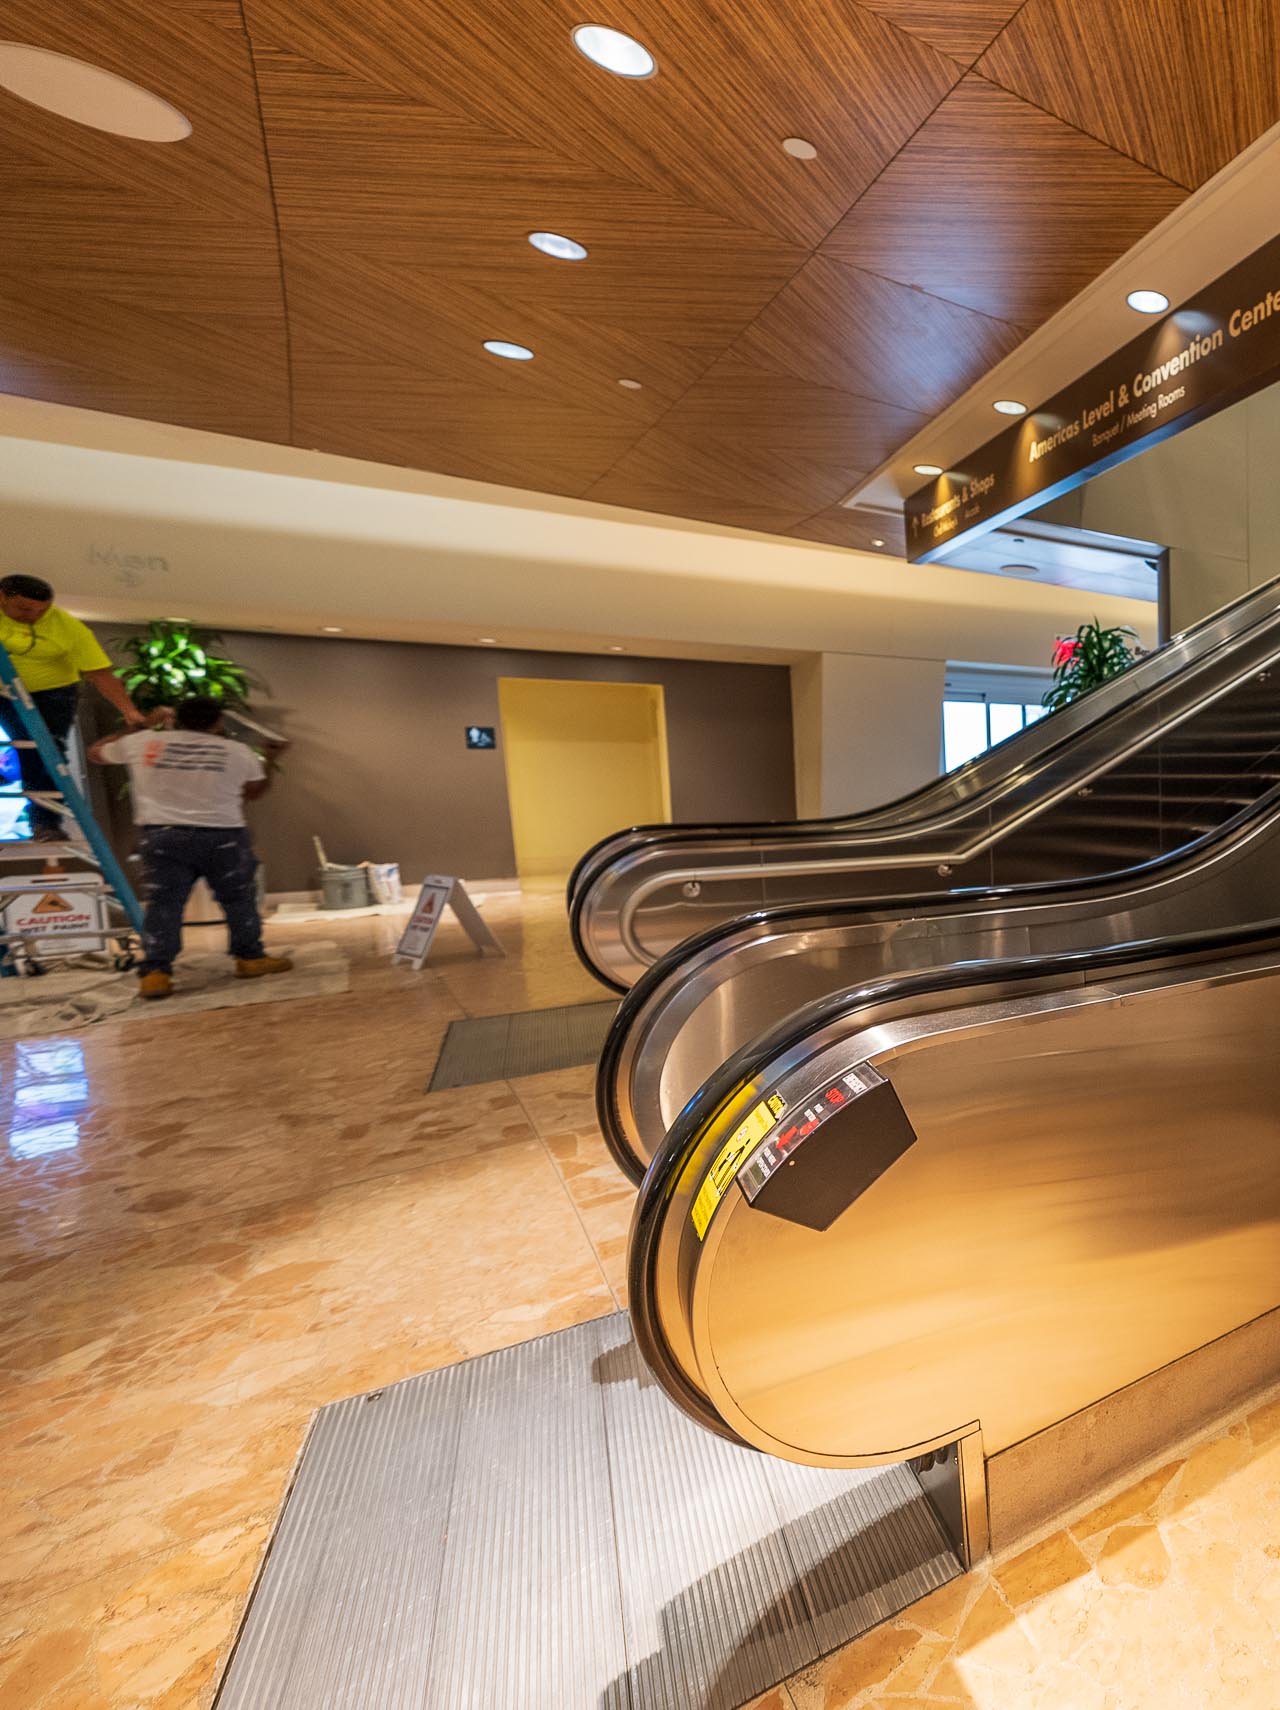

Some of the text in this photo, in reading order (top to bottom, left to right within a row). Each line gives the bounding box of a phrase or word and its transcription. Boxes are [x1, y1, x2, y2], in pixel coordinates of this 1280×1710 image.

[1029, 420, 1080, 463] Americas
[1082, 389, 1114, 430] Level
[1118, 384, 1130, 408] &
[1133, 329, 1223, 398] Convention
[1126, 403, 1157, 428] Meeting
[1158, 386, 1185, 410] Rooms
[15, 914, 91, 926] CAUTION
